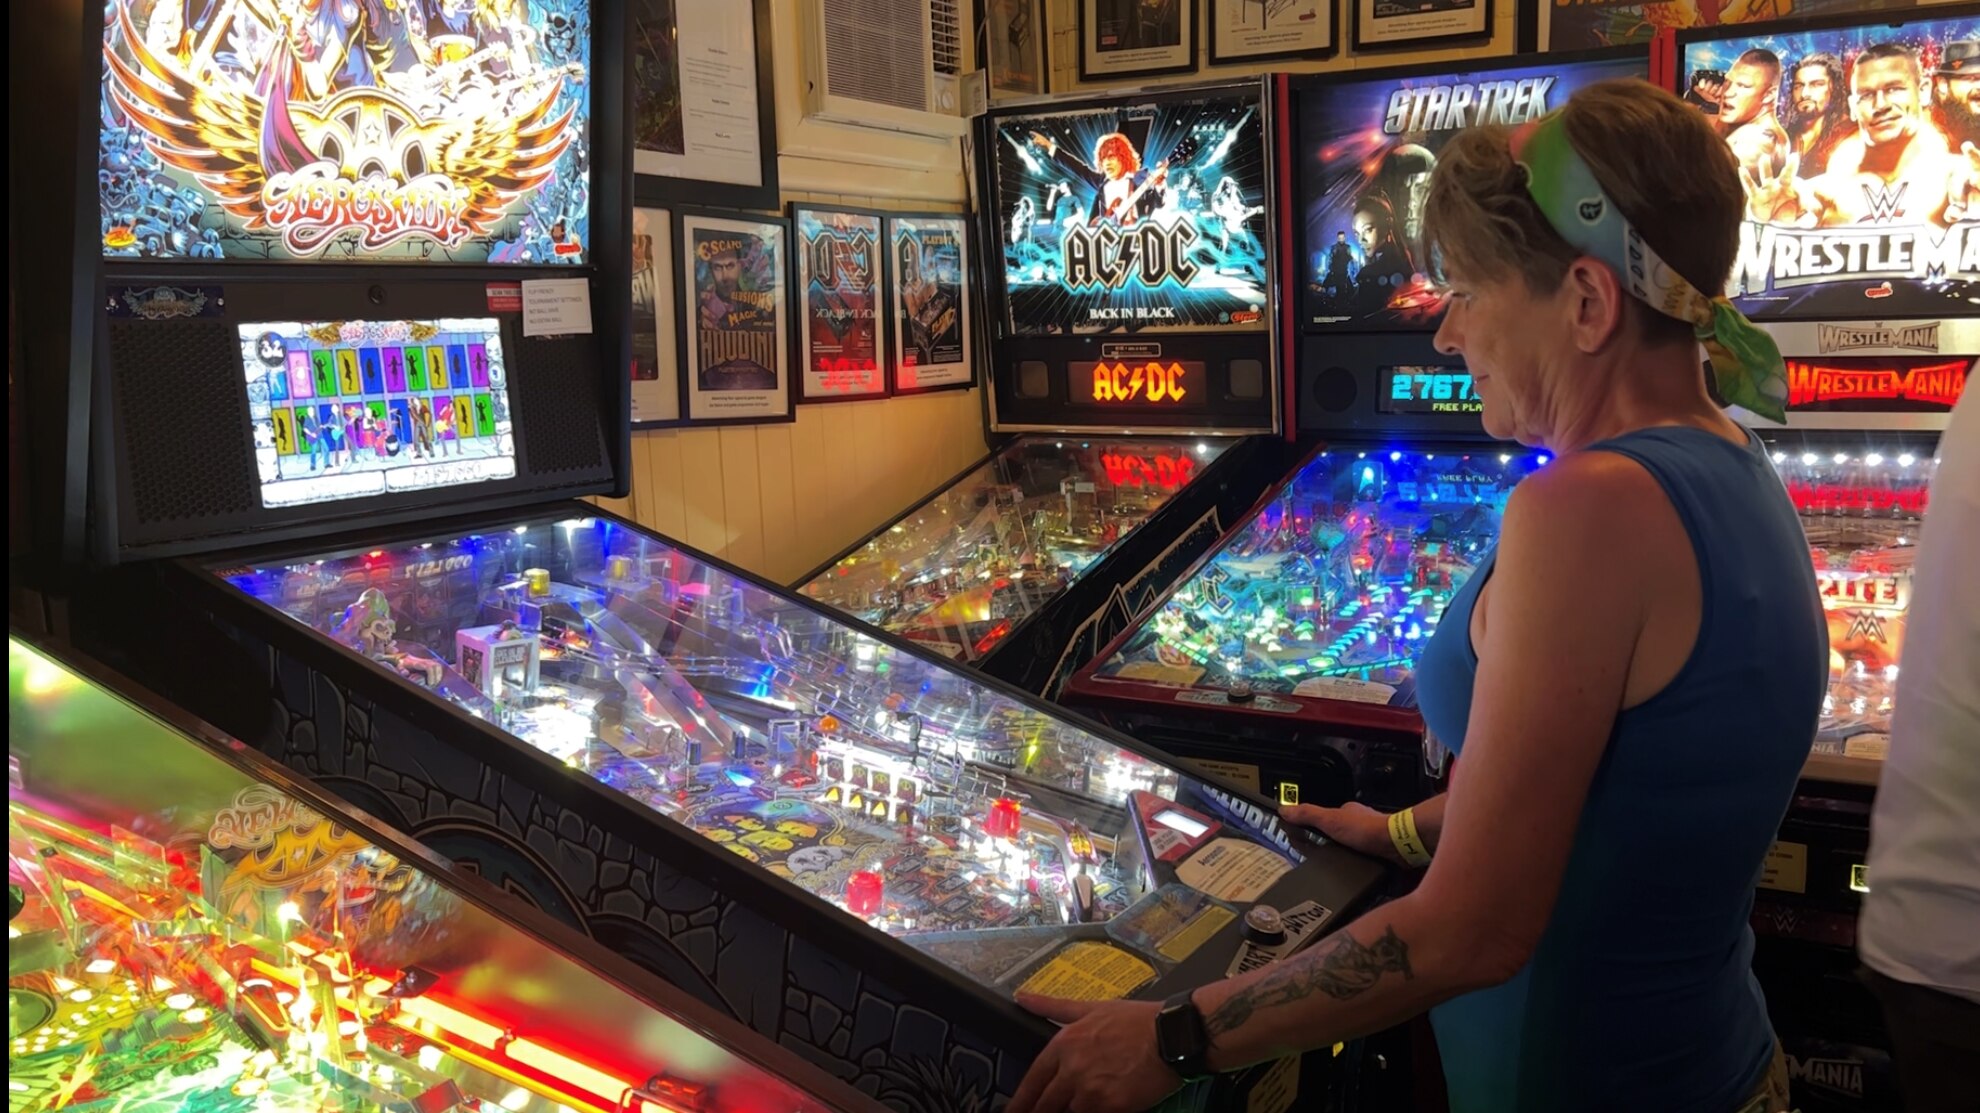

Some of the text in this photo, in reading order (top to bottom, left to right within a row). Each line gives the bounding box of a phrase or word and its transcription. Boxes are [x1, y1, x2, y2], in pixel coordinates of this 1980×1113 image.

[1383, 75, 1558, 134] STAR TREK
[1089, 306, 1175, 319] BACK IN BLACK
[700, 329, 775, 372] HOUDINI
[1391, 374, 1482, 401] 2,767,
[1432, 403, 1483, 412] FREE PLA
